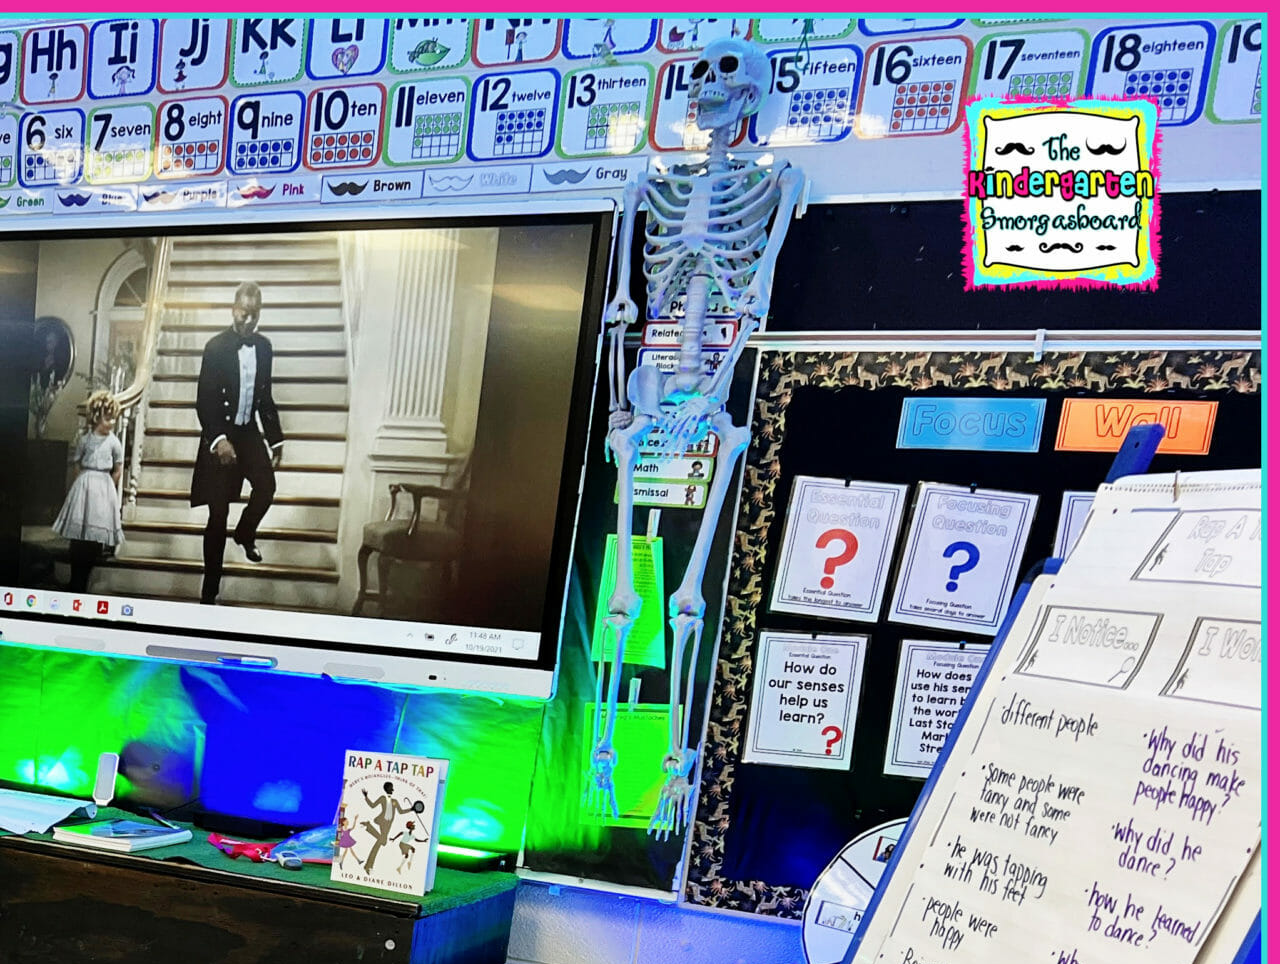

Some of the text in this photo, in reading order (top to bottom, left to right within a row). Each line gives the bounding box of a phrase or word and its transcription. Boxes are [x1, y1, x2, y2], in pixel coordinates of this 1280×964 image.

[30, 29, 77, 74] Hh
[107, 21, 140, 66] Ii
[26, 115, 46, 151] 6
[54, 125, 73, 140] six
[93, 113, 112, 151] 7
[111, 123, 151, 138] seven
[164, 103, 185, 141] 8
[188, 111, 223, 129] eight
[237, 100, 260, 139] 9
[261, 112, 293, 128] nine
[314, 90, 349, 132] 10
[351, 98, 377, 117] ten
[394, 85, 416, 128] 11
[416, 89, 465, 105] eleven
[480, 77, 511, 112] 12
[511, 88, 551, 103] twelve
[567, 73, 597, 108] 13
[597, 75, 648, 91] thirteen
[768, 56, 802, 94] 15
[800, 58, 856, 76] fifteen
[872, 45, 914, 86] 16
[911, 52, 962, 68] sixteen
[983, 38, 1026, 81] 17
[1020, 48, 1080, 62] seventeen
[1102, 33, 1142, 73] 18
[1140, 36, 1204, 54] eighteen
[17, 196, 45, 208] Green
[282, 180, 305, 196] Pink
[373, 178, 411, 193] Brown
[595, 166, 628, 181] Gray
[912, 404, 1026, 439] Focus
[634, 463, 659, 474] Math
[806, 511, 881, 531] Question
[937, 494, 1013, 520] Focusing
[932, 514, 1008, 537] Question
[1225, 515, 1248, 540] A
[1048, 615, 1067, 643] I
[1198, 627, 1219, 656] I
[784, 661, 837, 677] How do
[916, 669, 973, 682] How does
[768, 679, 846, 693] our senses
[911, 682, 948, 693] use his
[912, 694, 957, 706] to learn
[779, 694, 829, 710] help us
[913, 706, 932, 716] the
[779, 710, 826, 725] learn?
[909, 718, 933, 728] Last
[1001, 692, 1099, 742] different people
[1182, 731, 1241, 766] did his
[348, 755, 434, 778] RAP A TAP TAP
[1142, 745, 1246, 797] dancing make
[980, 779, 1010, 814] fancy
[1014, 795, 1038, 815] and
[1018, 774, 1086, 804] people were
[1133, 779, 1177, 810] people
[970, 807, 1059, 846] were not fancy
[1147, 826, 1203, 862] did he
[951, 835, 1048, 900] he was tapping
[387, 881, 413, 890] DILLON
[944, 862, 1028, 907] with his feet
[922, 897, 999, 938] people were
[1088, 881, 1201, 944] how he learned
[1088, 907, 1102, 932] to
[929, 916, 965, 952] happy
